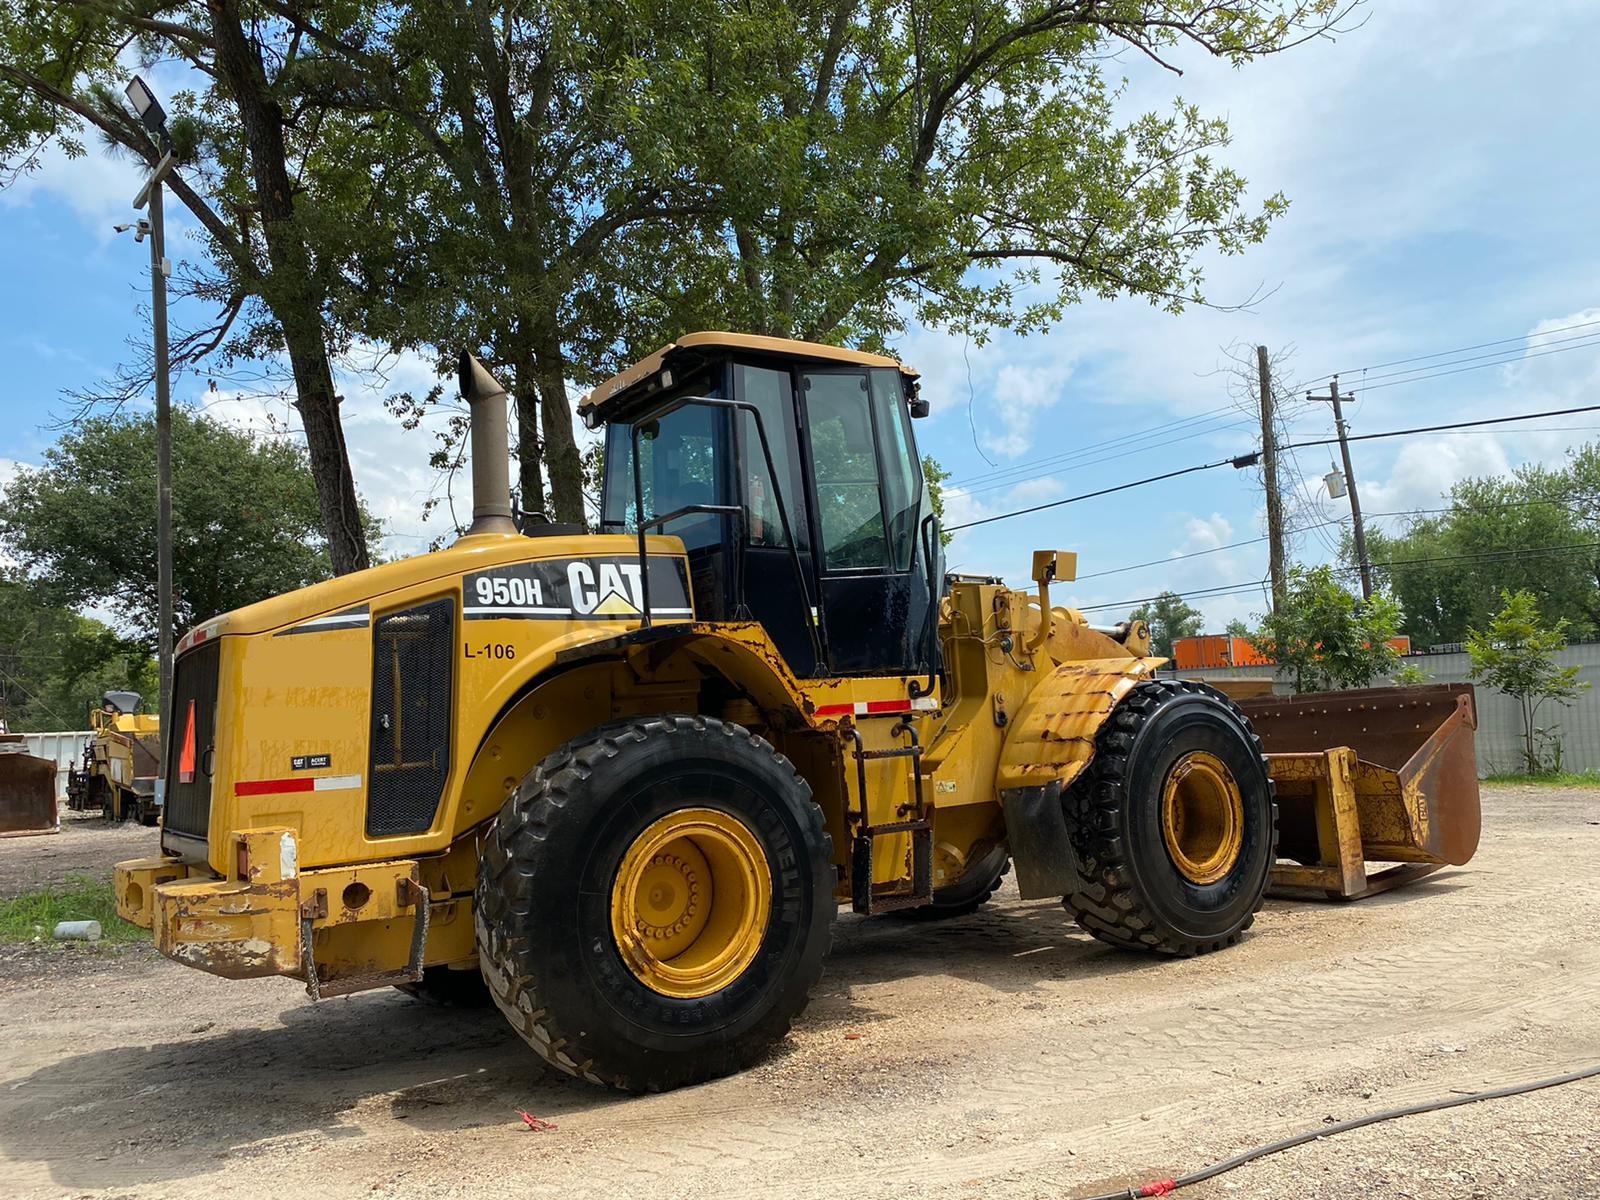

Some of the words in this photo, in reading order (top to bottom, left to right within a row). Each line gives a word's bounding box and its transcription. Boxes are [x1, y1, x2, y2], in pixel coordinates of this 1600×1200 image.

[475, 576, 543, 606] 950H
[566, 561, 649, 615] CAT
[464, 643, 515, 660] L-106
